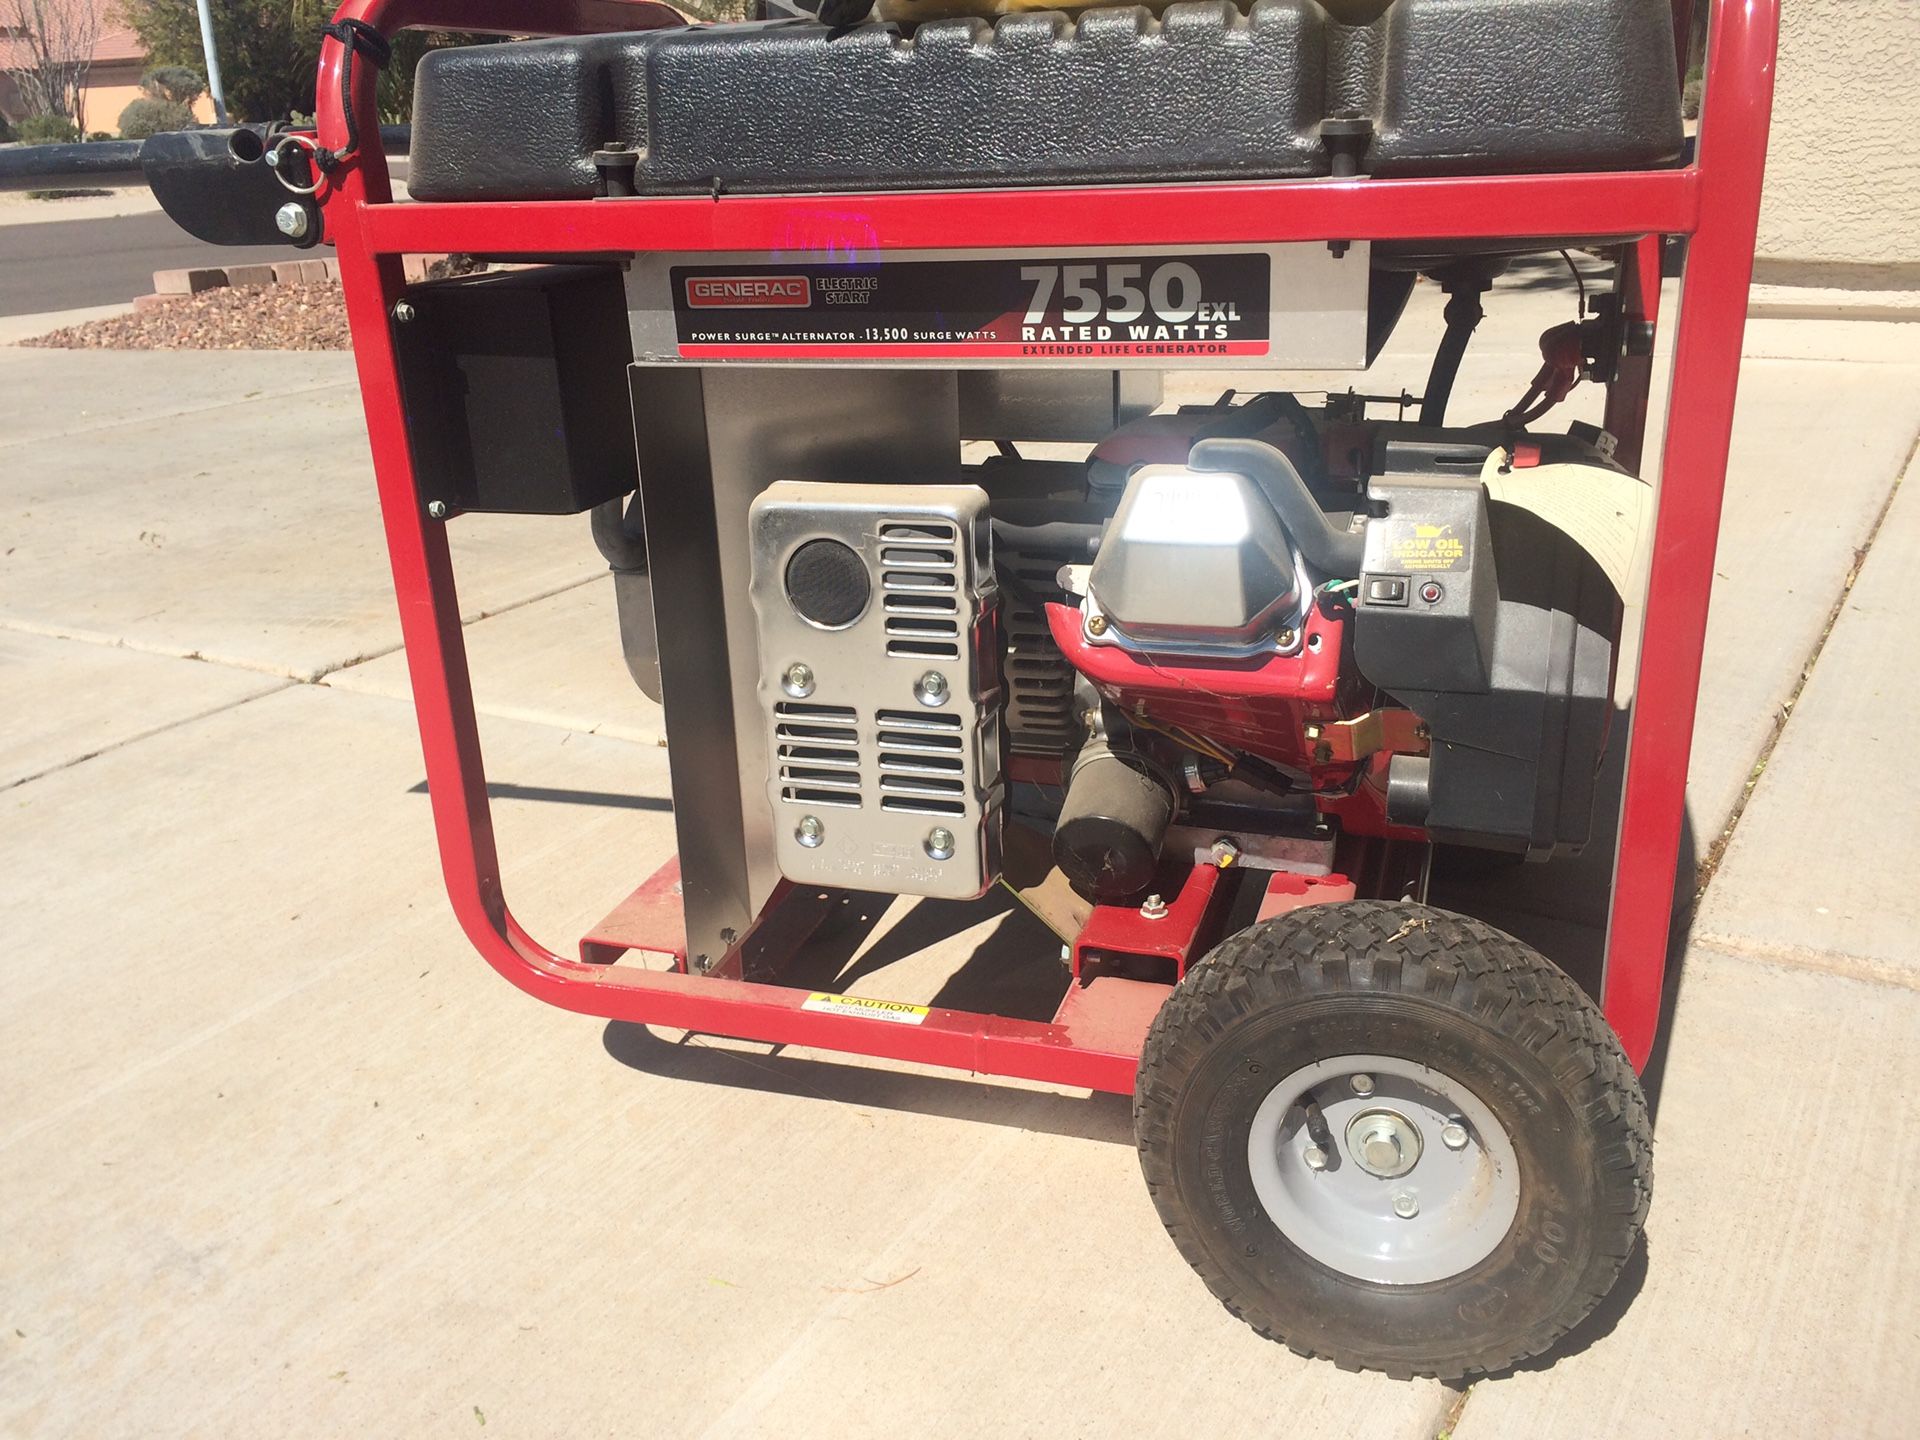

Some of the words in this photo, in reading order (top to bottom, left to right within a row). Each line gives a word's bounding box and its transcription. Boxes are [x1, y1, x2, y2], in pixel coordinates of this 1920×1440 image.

[695, 282, 801, 297] GENERAC
[816, 278, 878, 290] ELECTRIC
[825, 291, 870, 304] START
[1020, 261, 1203, 324] 7550
[1198, 302, 1241, 322] EXL
[691, 332, 731, 341] POWER
[781, 332, 855, 341] ALTERNATOR
[913, 332, 952, 341] SURGE
[955, 331, 997, 340] WATTS
[1021, 325, 1112, 342] RATED
[1128, 324, 1229, 341] WATTS
[1022, 345, 1094, 356] EXTENDED
[1101, 345, 1131, 355] LIFE
[1135, 344, 1228, 355] GENERATOR
[1392, 538, 1431, 550] LOW
[1435, 538, 1463, 550] OIL
[1392, 550, 1463, 558] INDICATOR
[840, 997, 915, 1013] CAUTION
